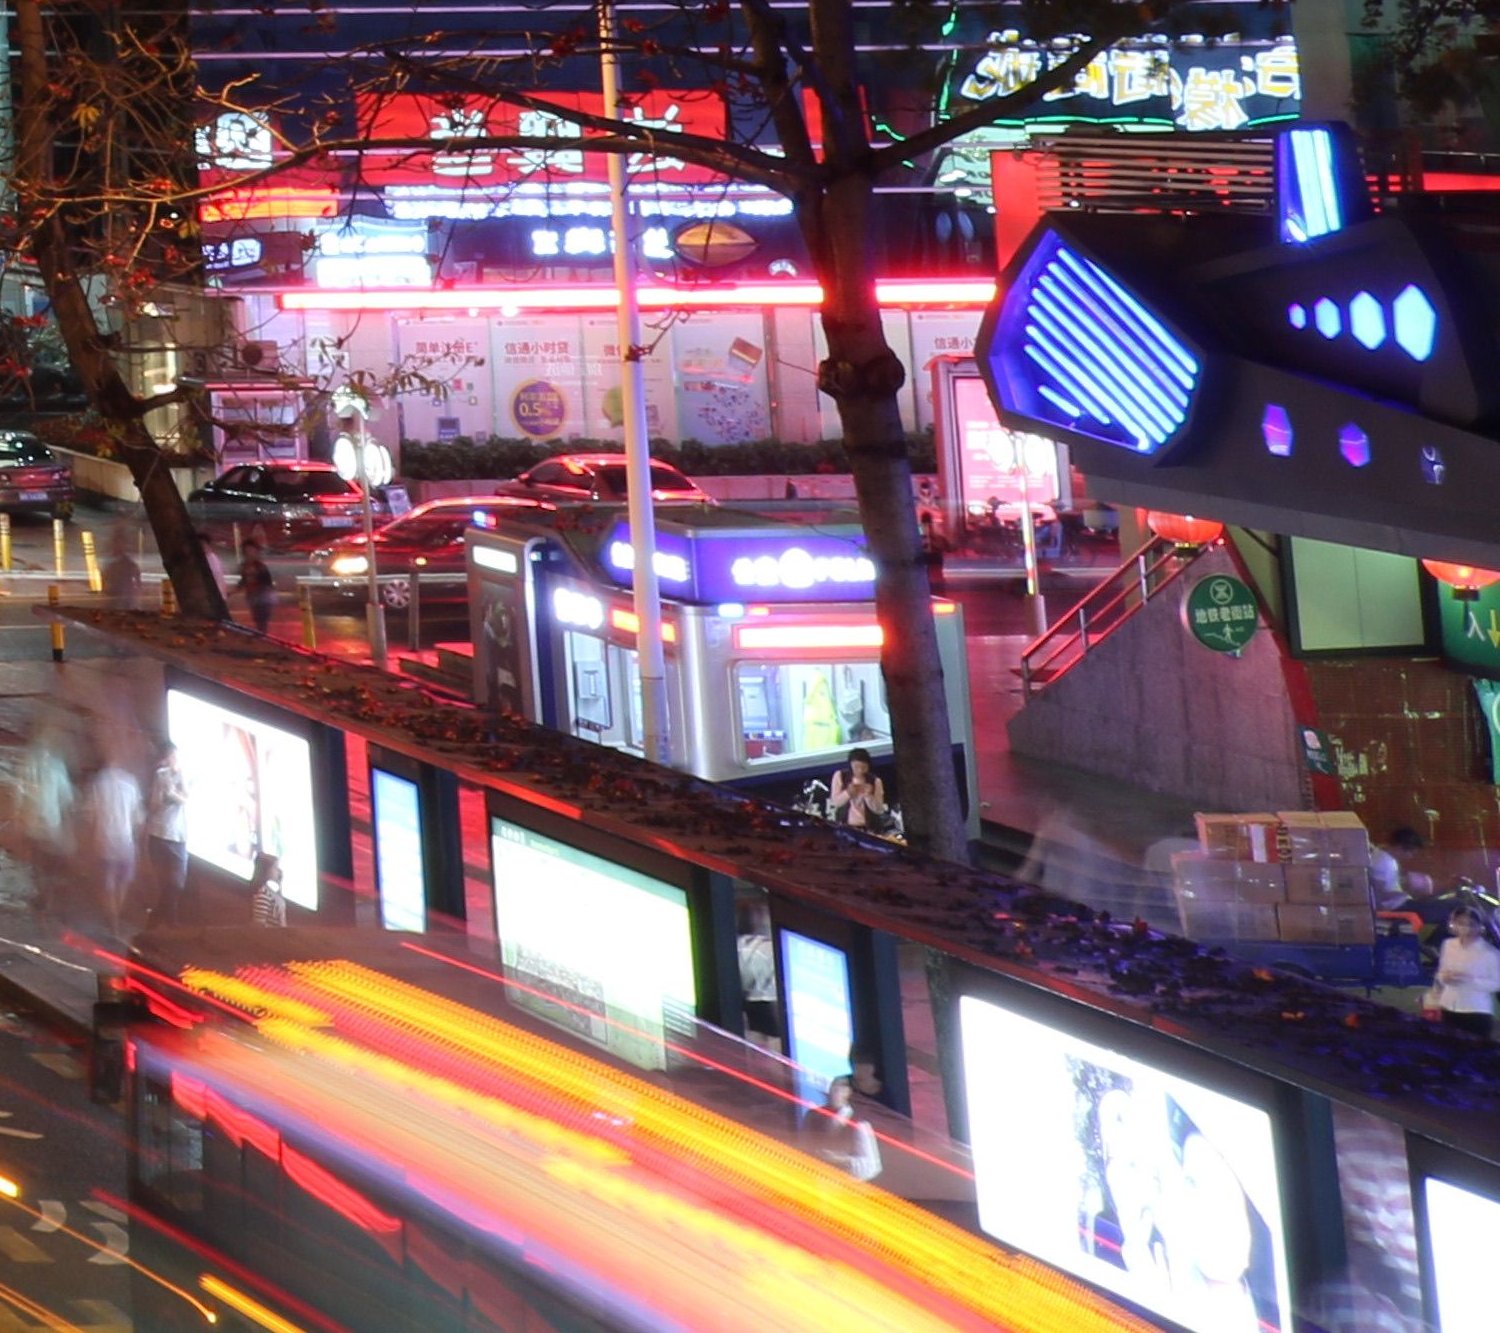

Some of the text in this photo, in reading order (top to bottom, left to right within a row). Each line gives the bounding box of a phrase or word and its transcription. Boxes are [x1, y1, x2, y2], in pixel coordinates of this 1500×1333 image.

[934, 336, 975, 351] 信通小
[1195, 604, 1255, 624] 地铁老街站
